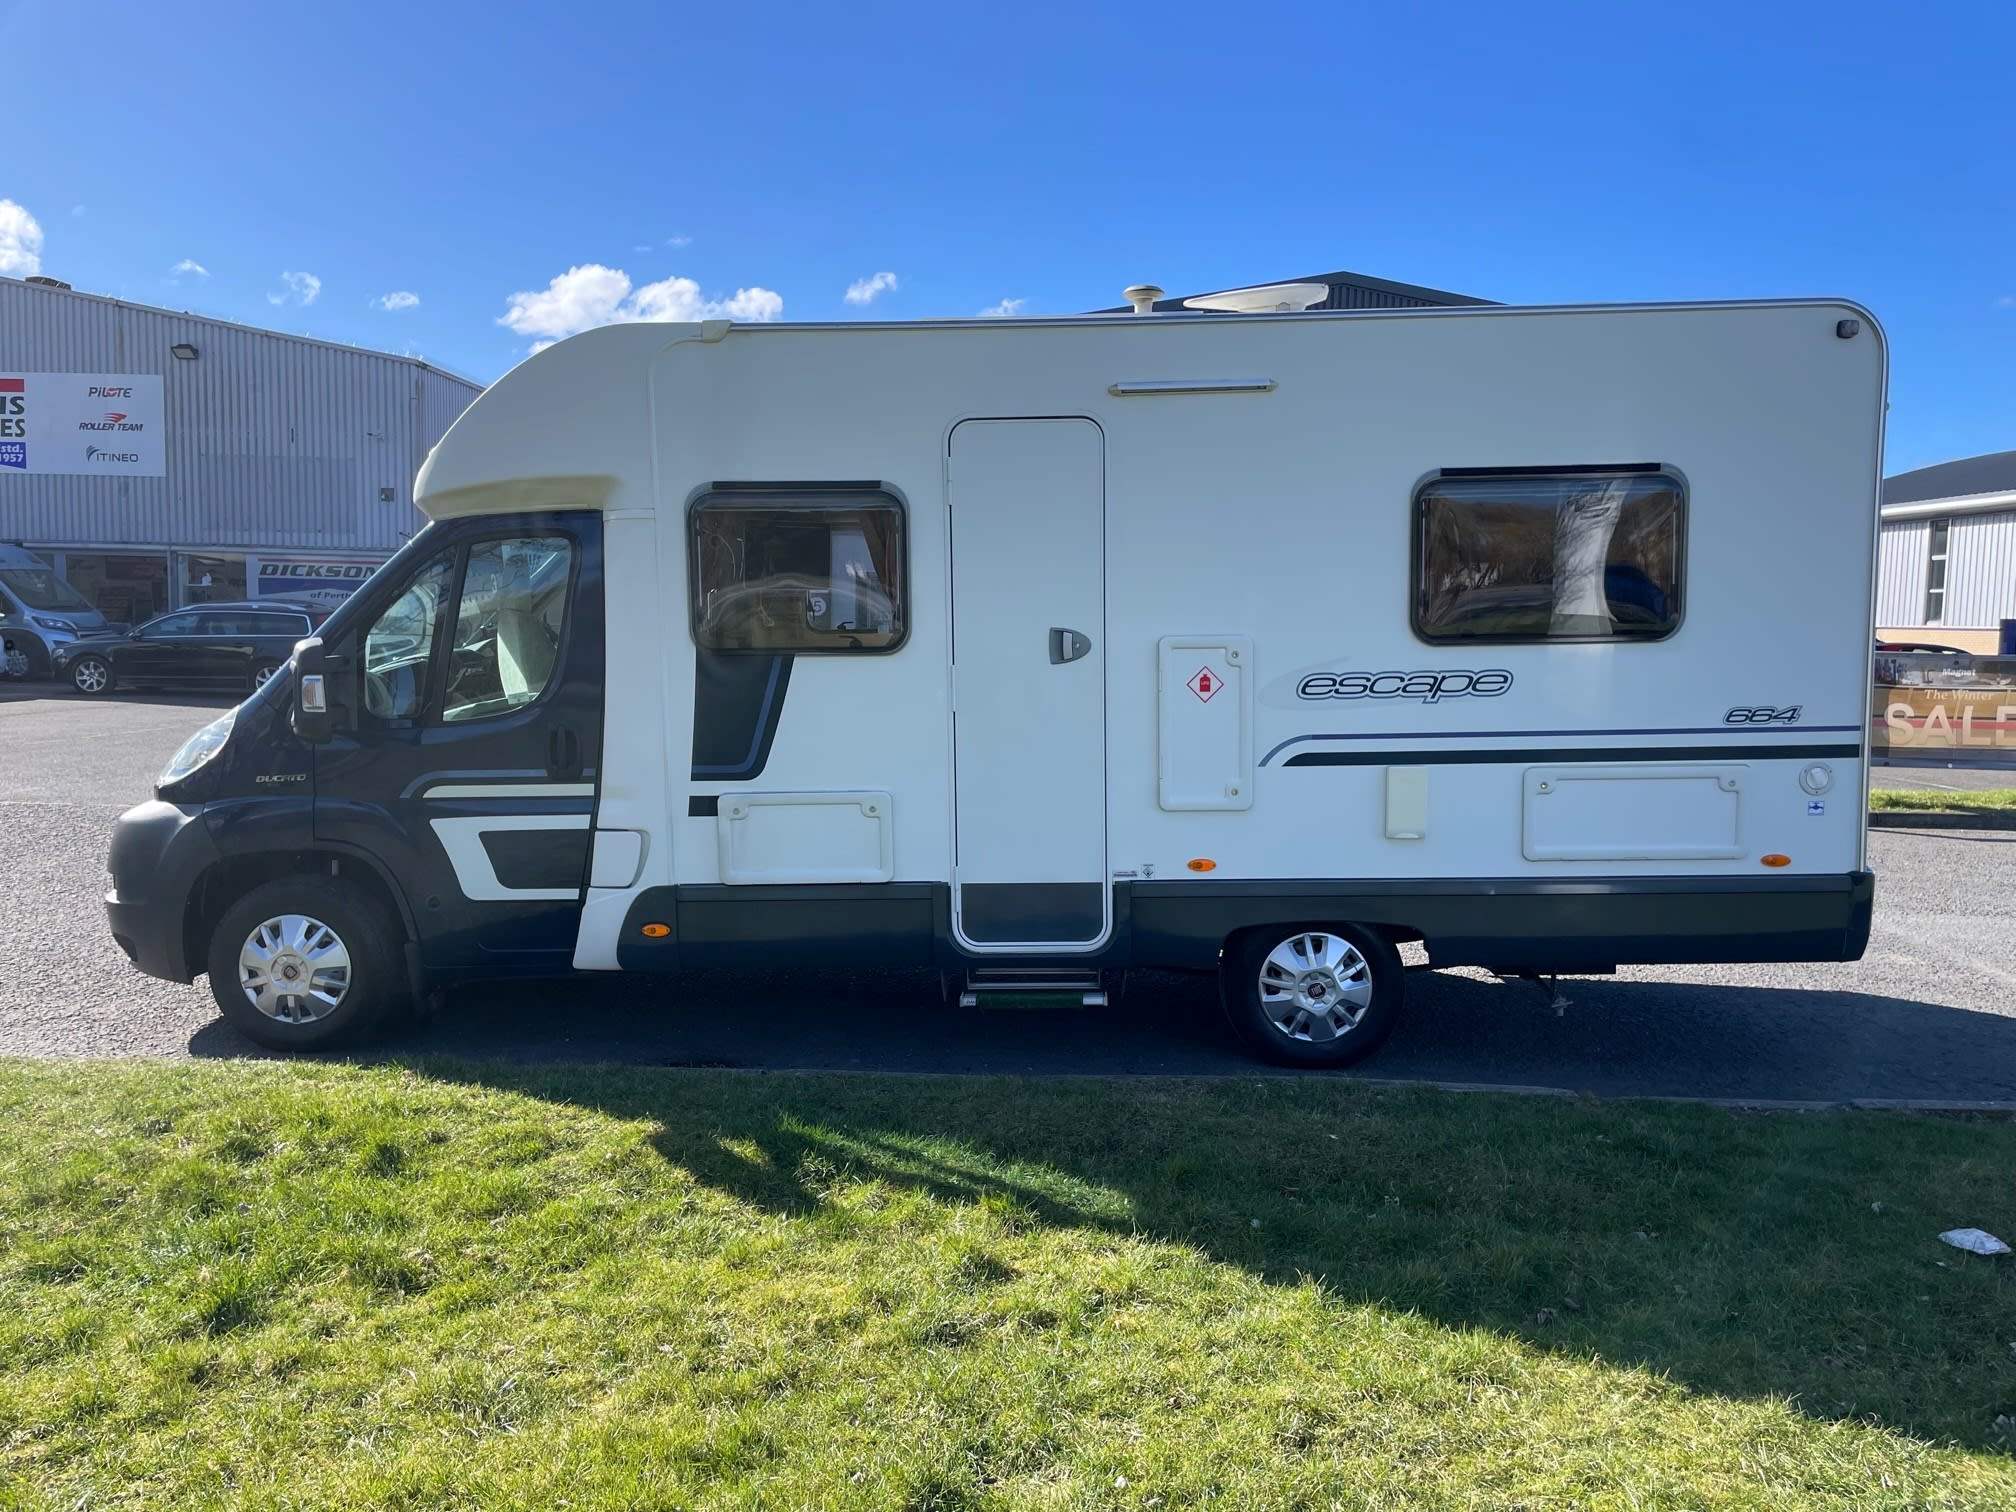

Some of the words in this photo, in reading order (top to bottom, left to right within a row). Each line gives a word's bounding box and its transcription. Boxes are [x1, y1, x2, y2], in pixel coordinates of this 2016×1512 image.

[79, 422, 115, 431] ROLLER
[117, 423, 144, 432] TEAM
[310, 591, 322, 599] of
[1298, 670, 1512, 703] escape
[1924, 689, 1948, 700] The
[1951, 689, 1993, 701] Winter
[1724, 705, 1802, 724] 664
[1887, 702, 2016, 747] SALE
